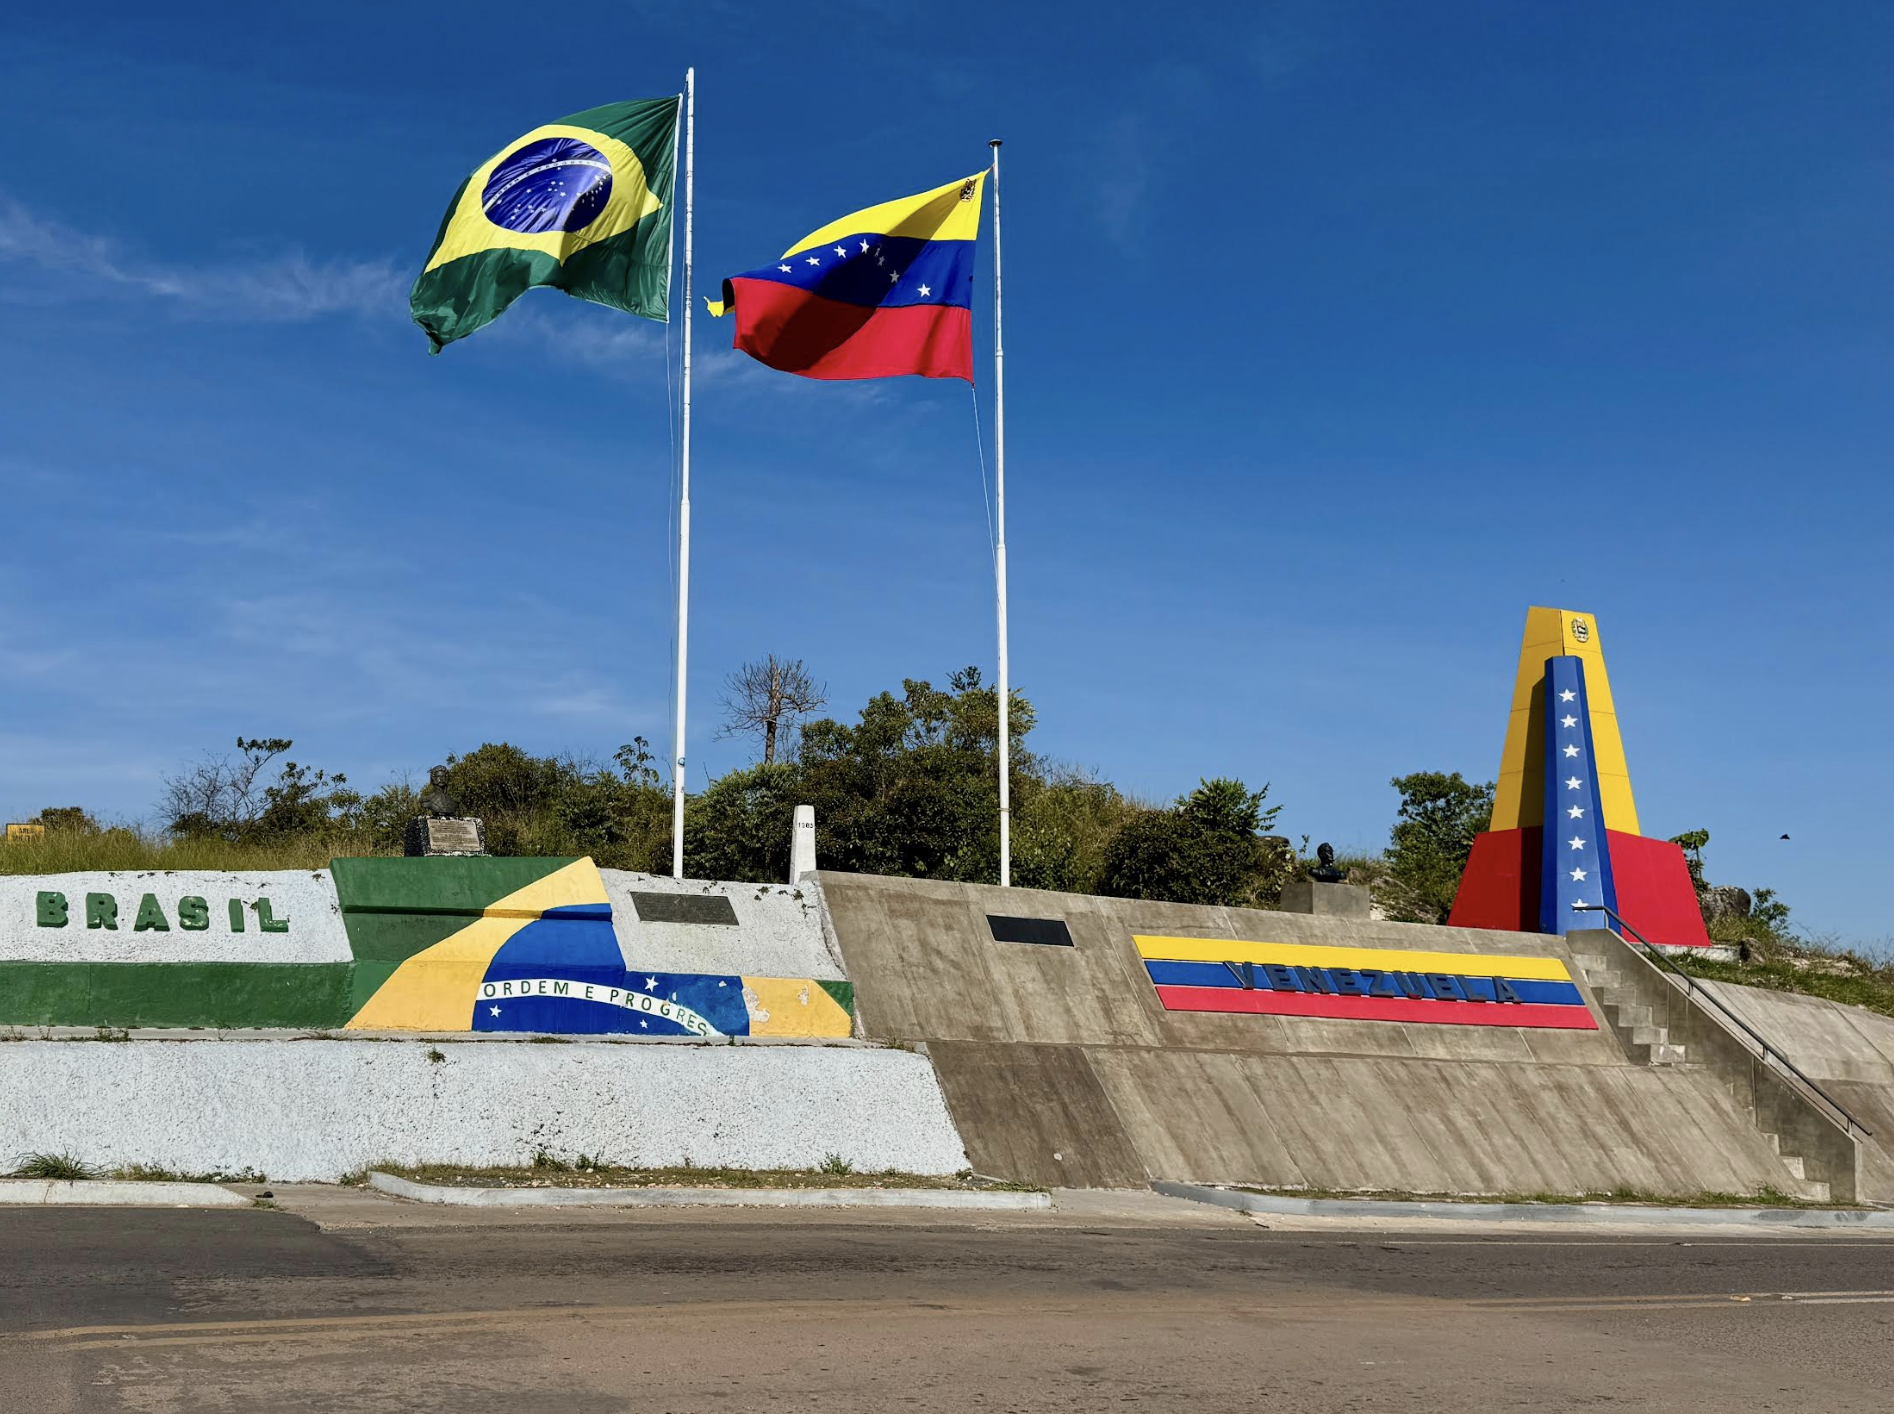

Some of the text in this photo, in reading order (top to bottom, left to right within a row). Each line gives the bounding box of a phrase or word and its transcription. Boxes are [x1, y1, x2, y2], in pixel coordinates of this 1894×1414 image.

[36, 891, 289, 933] BRASIL
[1223, 961, 1522, 1004] VENEZUELA
[484, 980, 707, 1037] ORDEM E PROGRES
